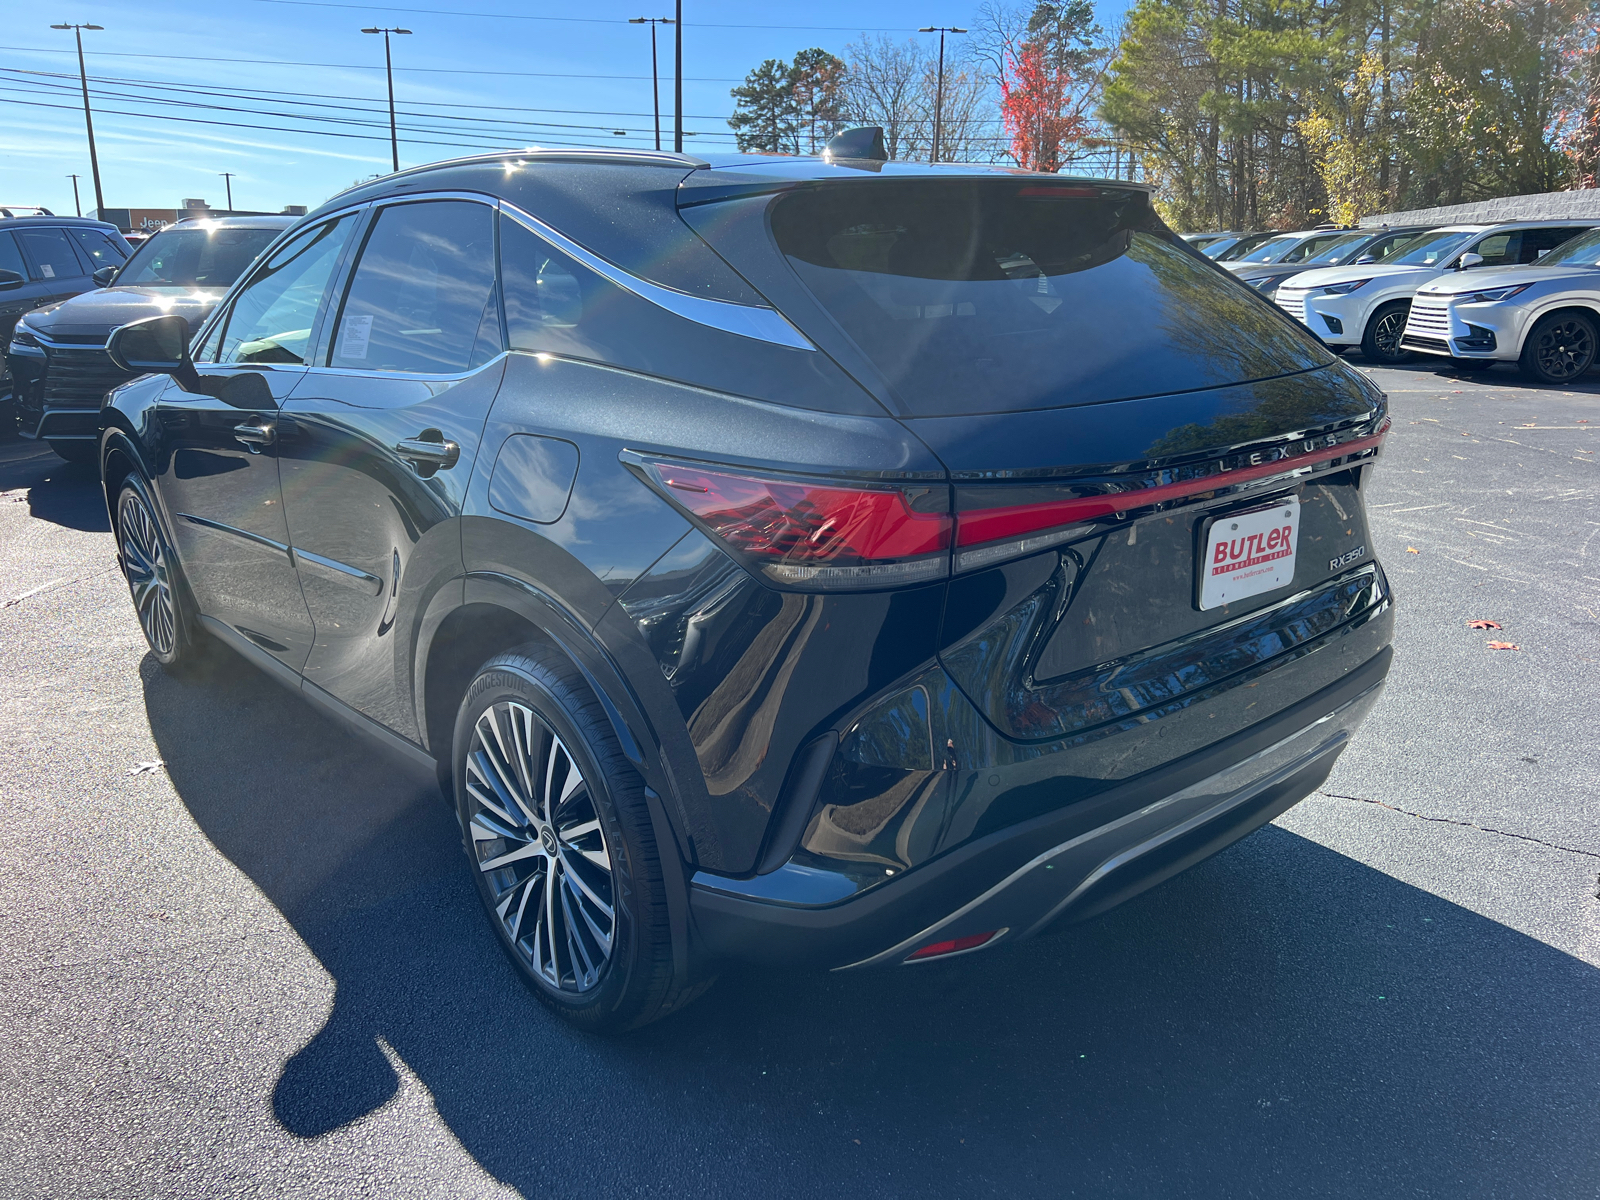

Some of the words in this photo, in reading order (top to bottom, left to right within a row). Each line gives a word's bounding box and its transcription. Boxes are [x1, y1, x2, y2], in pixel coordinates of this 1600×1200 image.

[140, 216, 168, 229] Jeep
[1219, 433, 1337, 473] LEXUS
[1213, 557, 1262, 575] AUTOMOTIVE
[1269, 548, 1291, 560] GROUP
[1329, 545, 1365, 571] RX350
[1232, 566, 1274, 581] www.butlercars.com
[466, 672, 528, 708] BRIDGESTONE
[602, 800, 632, 897] ALENZA
